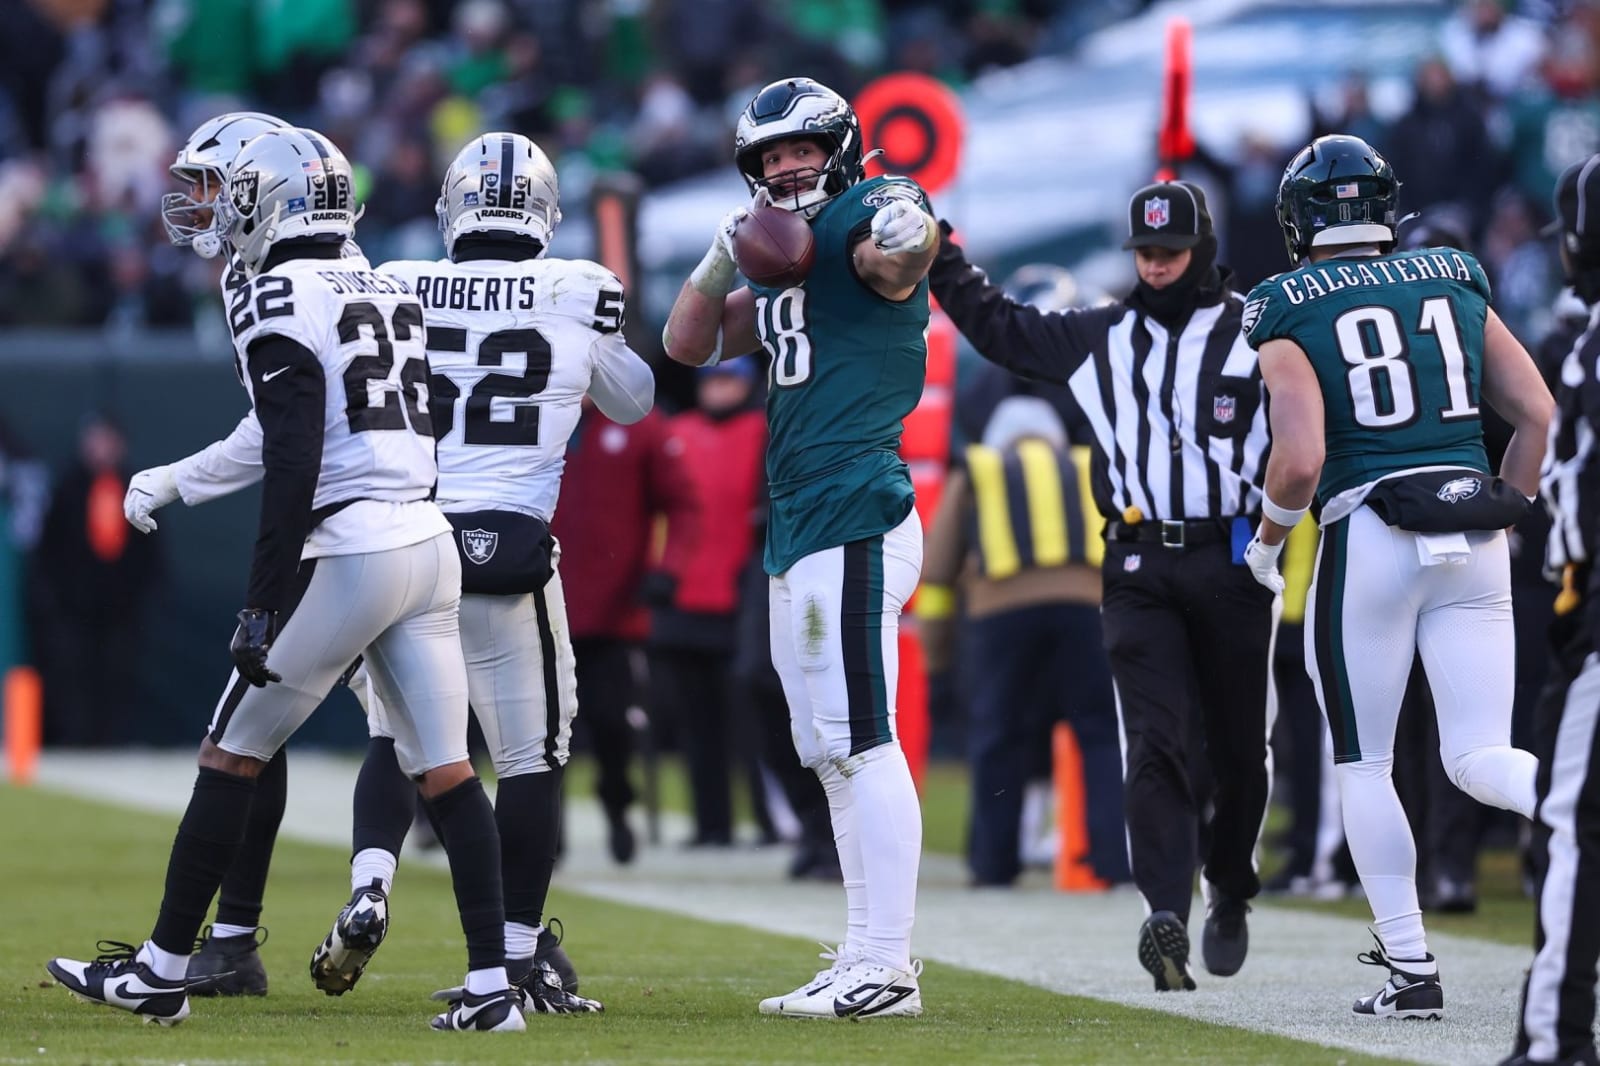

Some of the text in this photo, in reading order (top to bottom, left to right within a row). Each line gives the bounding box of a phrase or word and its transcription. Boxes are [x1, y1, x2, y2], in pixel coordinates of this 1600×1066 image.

[311, 212, 348, 221] RAIDERS
[481, 209, 524, 220] RAIDERS
[416, 276, 535, 311] ROBERTS
[1281, 254, 1472, 306] CALCATERRA
[229, 275, 295, 339] 22
[592, 289, 625, 335] 5
[1333, 298, 1480, 427] 81
